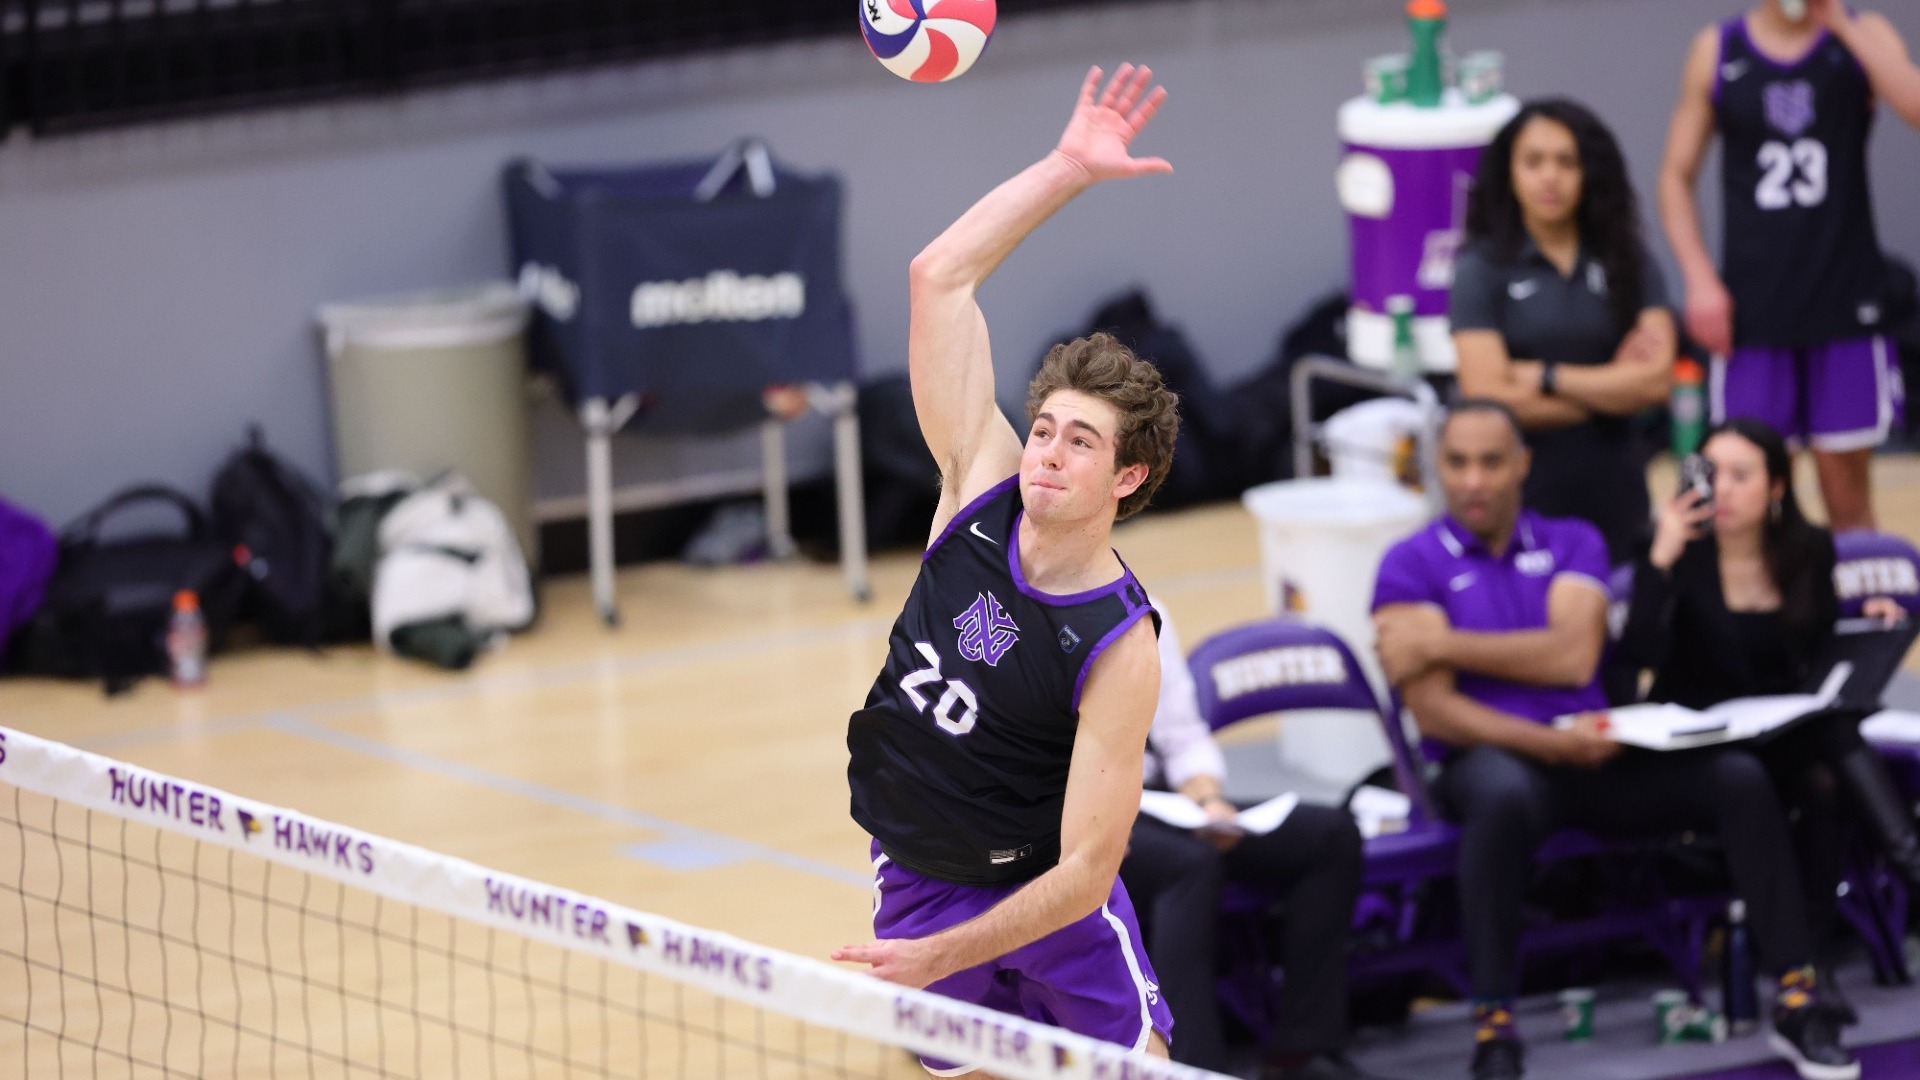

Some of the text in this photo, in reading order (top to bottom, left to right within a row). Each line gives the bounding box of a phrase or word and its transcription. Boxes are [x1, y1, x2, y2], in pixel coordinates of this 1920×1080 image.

[1756, 138, 1828, 209] 23
[900, 641, 978, 736] 20
[1211, 645, 1347, 700] HUNTER
[108, 767, 375, 874] HUNTER HAWKS
[484, 877, 772, 992] HUNTER HAWKS
[895, 996, 1032, 1069] HUNTER
